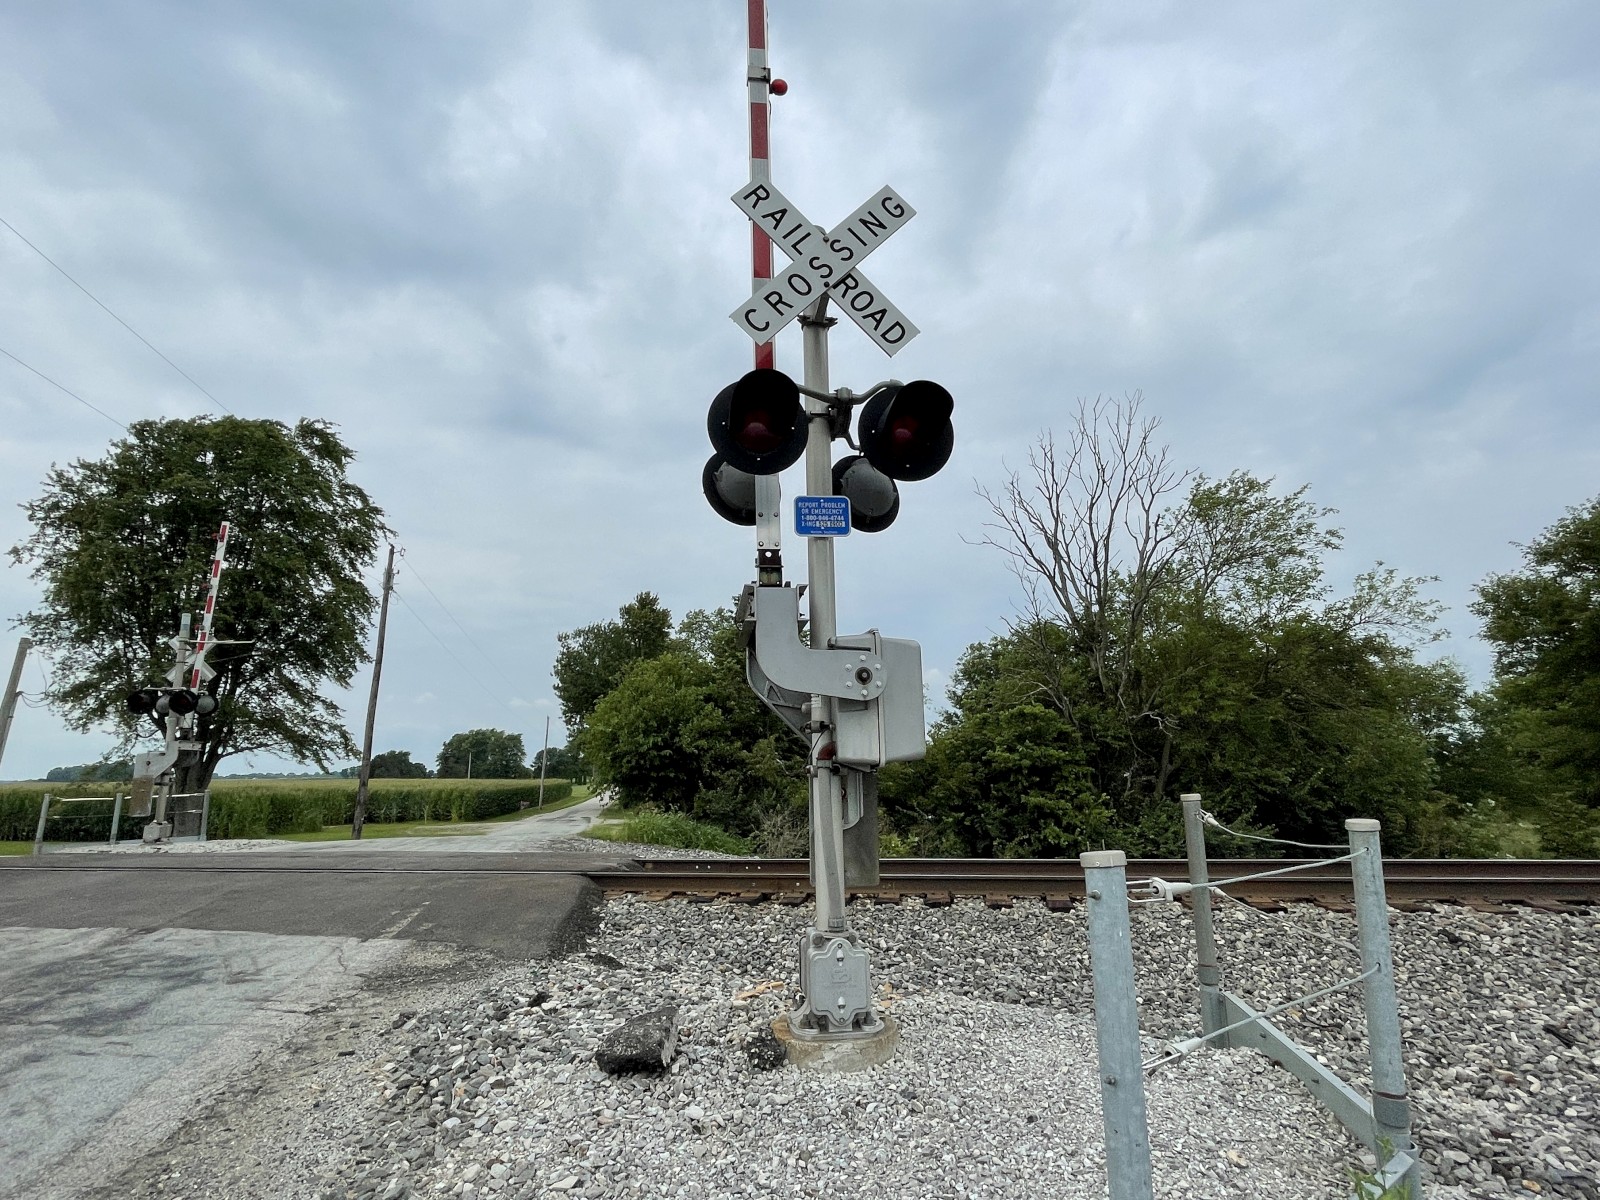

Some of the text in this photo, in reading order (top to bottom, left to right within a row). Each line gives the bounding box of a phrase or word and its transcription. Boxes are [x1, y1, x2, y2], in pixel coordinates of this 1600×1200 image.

[743, 184, 906, 344] RAIL ROAD
[744, 196, 905, 332] CROSSING
